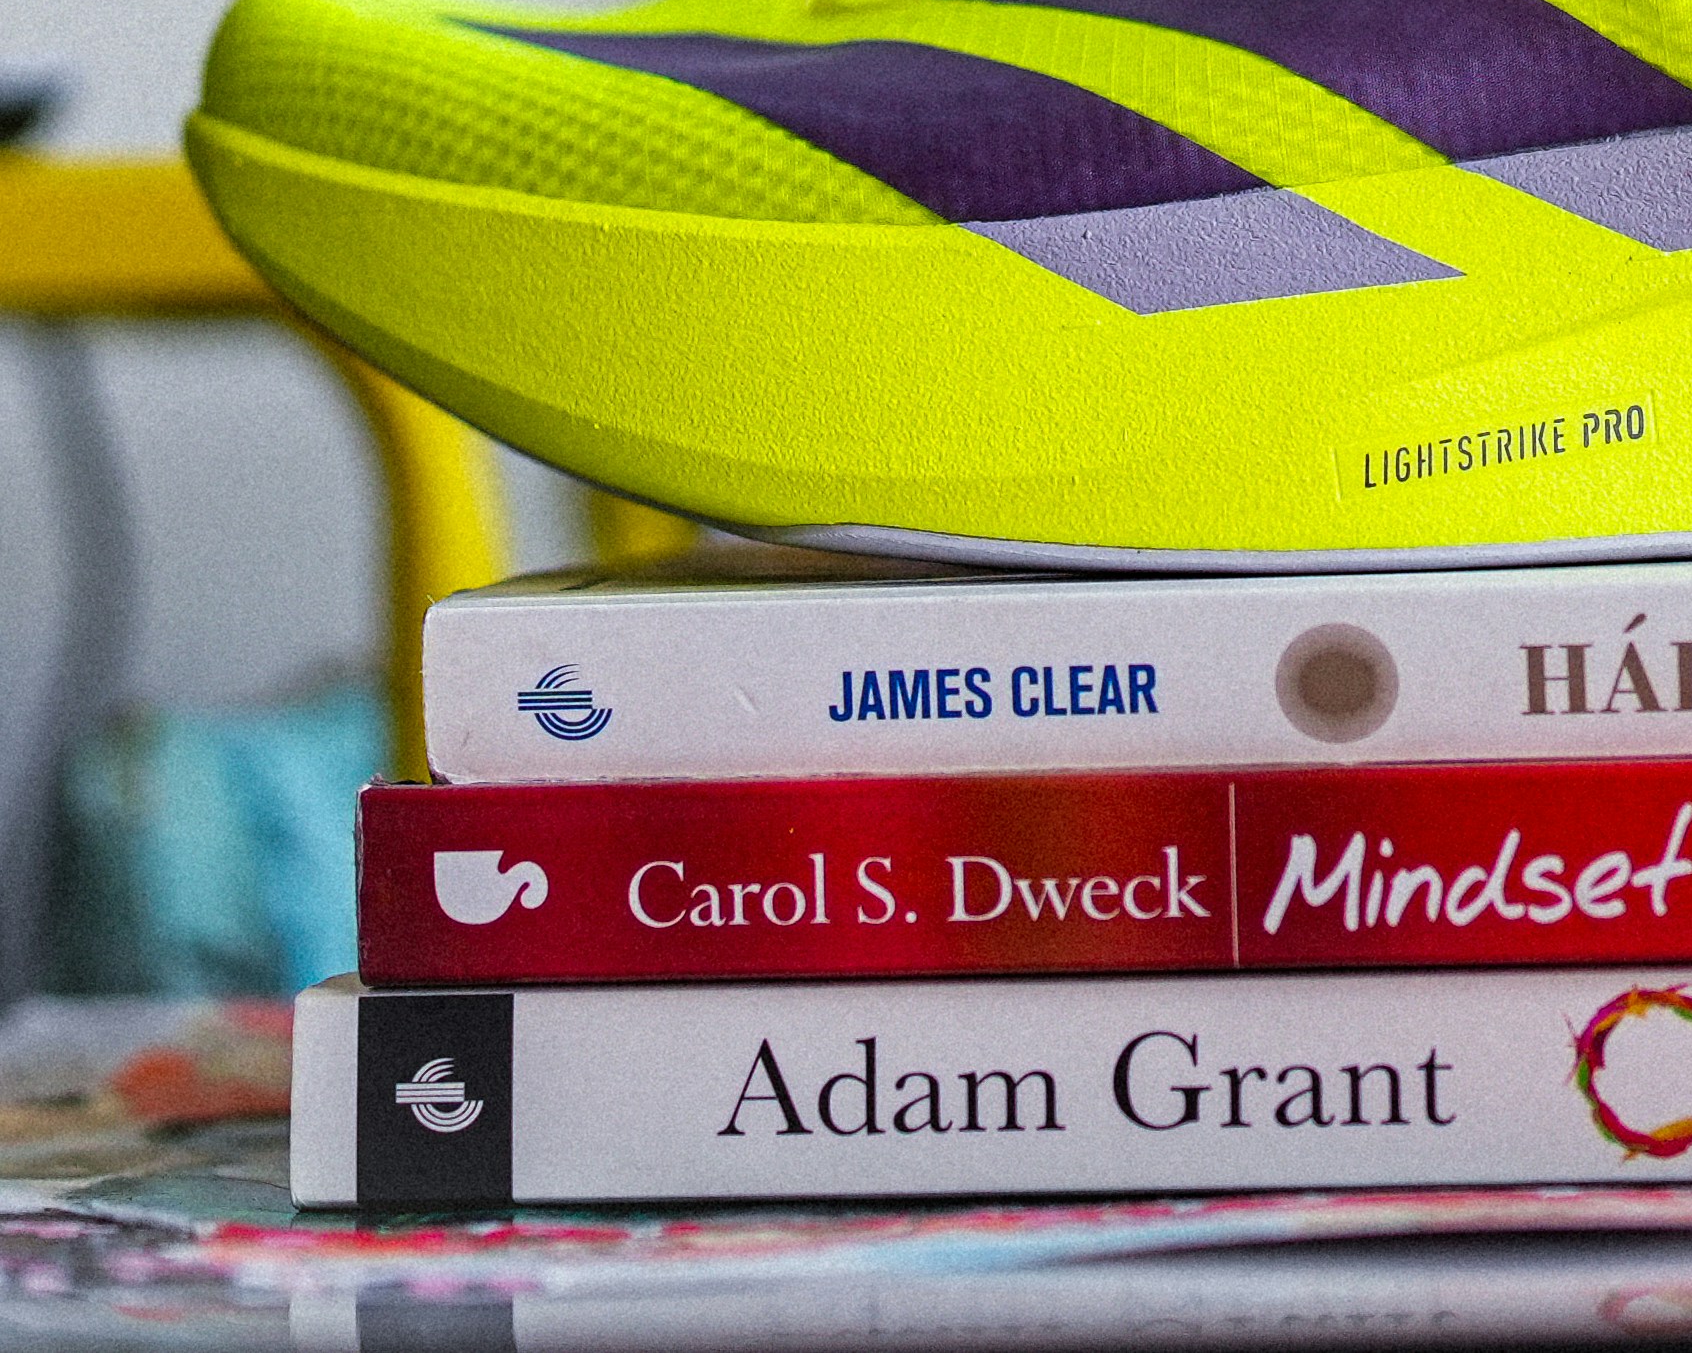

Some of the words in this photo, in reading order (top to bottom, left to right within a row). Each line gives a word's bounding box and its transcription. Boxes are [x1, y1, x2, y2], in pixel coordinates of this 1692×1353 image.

[1363, 417, 1566, 489] LIGHTSTRIKE
[1582, 404, 1645, 449] PRO
[828, 667, 993, 723] JAMES
[1010, 663, 1159, 718] CLEAR
[627, 852, 831, 930] Carol
[855, 855, 918, 925] S.
[945, 845, 1212, 923] Dweck
[716, 1036, 1067, 1138] Adam
[1111, 1029, 1458, 1131] Grant
